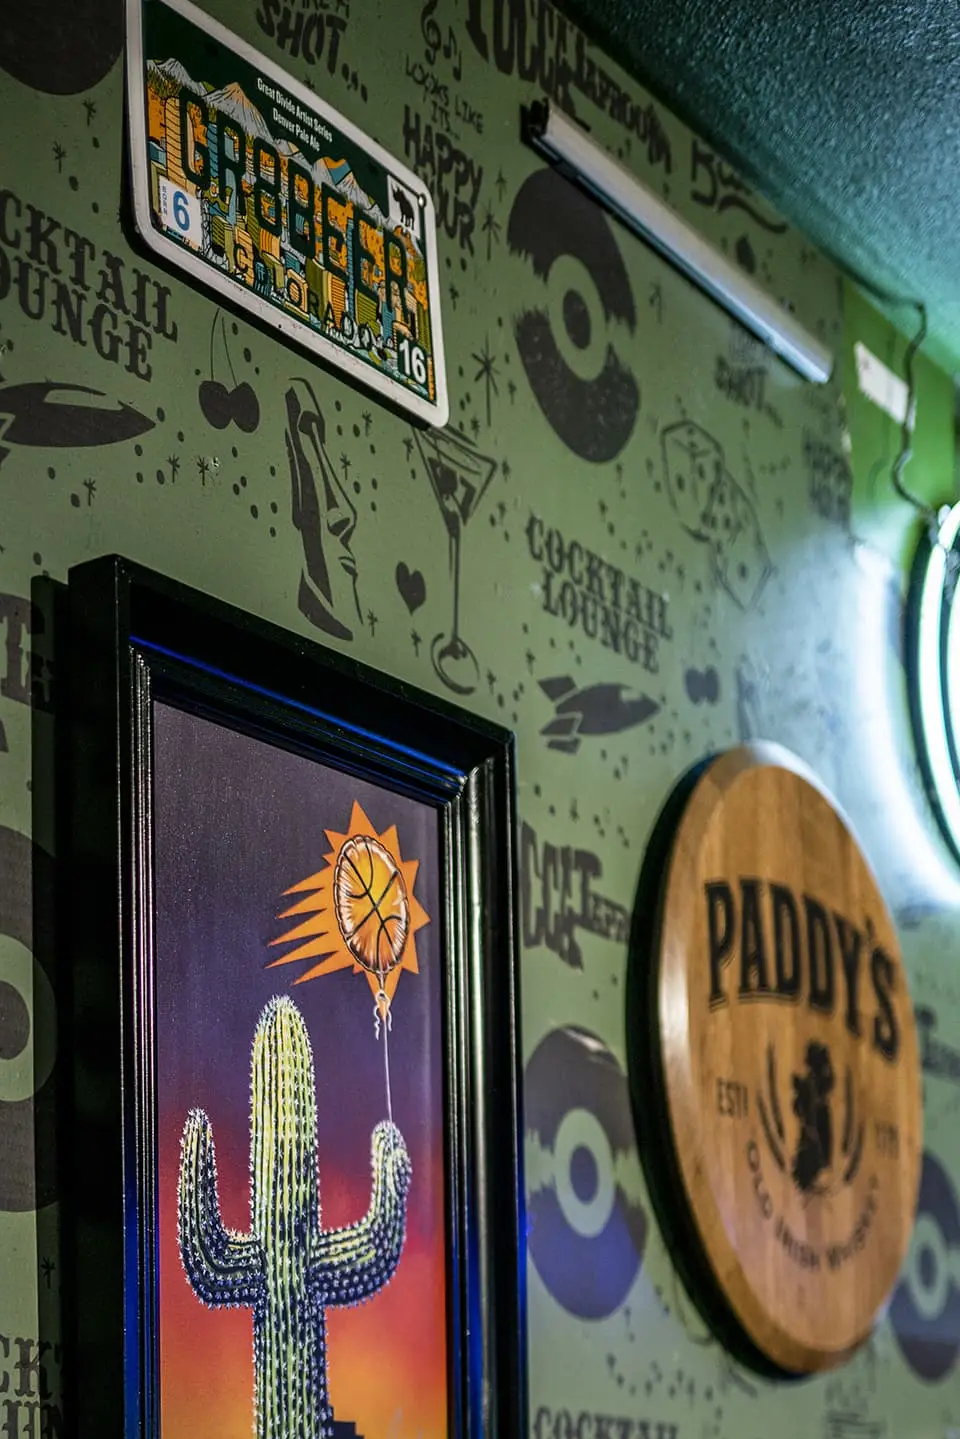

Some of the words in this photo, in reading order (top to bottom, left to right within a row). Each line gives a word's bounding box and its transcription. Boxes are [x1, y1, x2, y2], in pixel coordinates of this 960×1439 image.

[257, 78, 276, 101] Great
[276, 90, 296, 115] Divide
[296, 105, 313, 128] Artist
[313, 117, 333, 143] Series
[273, 106, 295, 133] Denver
[295, 123, 309, 144] Pale
[309, 134, 320, 151] Ale
[402, 103, 484, 210] HAPPY
[172, 189, 191, 232] 6
[398, 339, 426, 385] 16
[525, 512, 674, 641] COCKTAIL
[542, 571, 660, 674] LOUNGE
[747, 1139, 774, 1222] OLD
